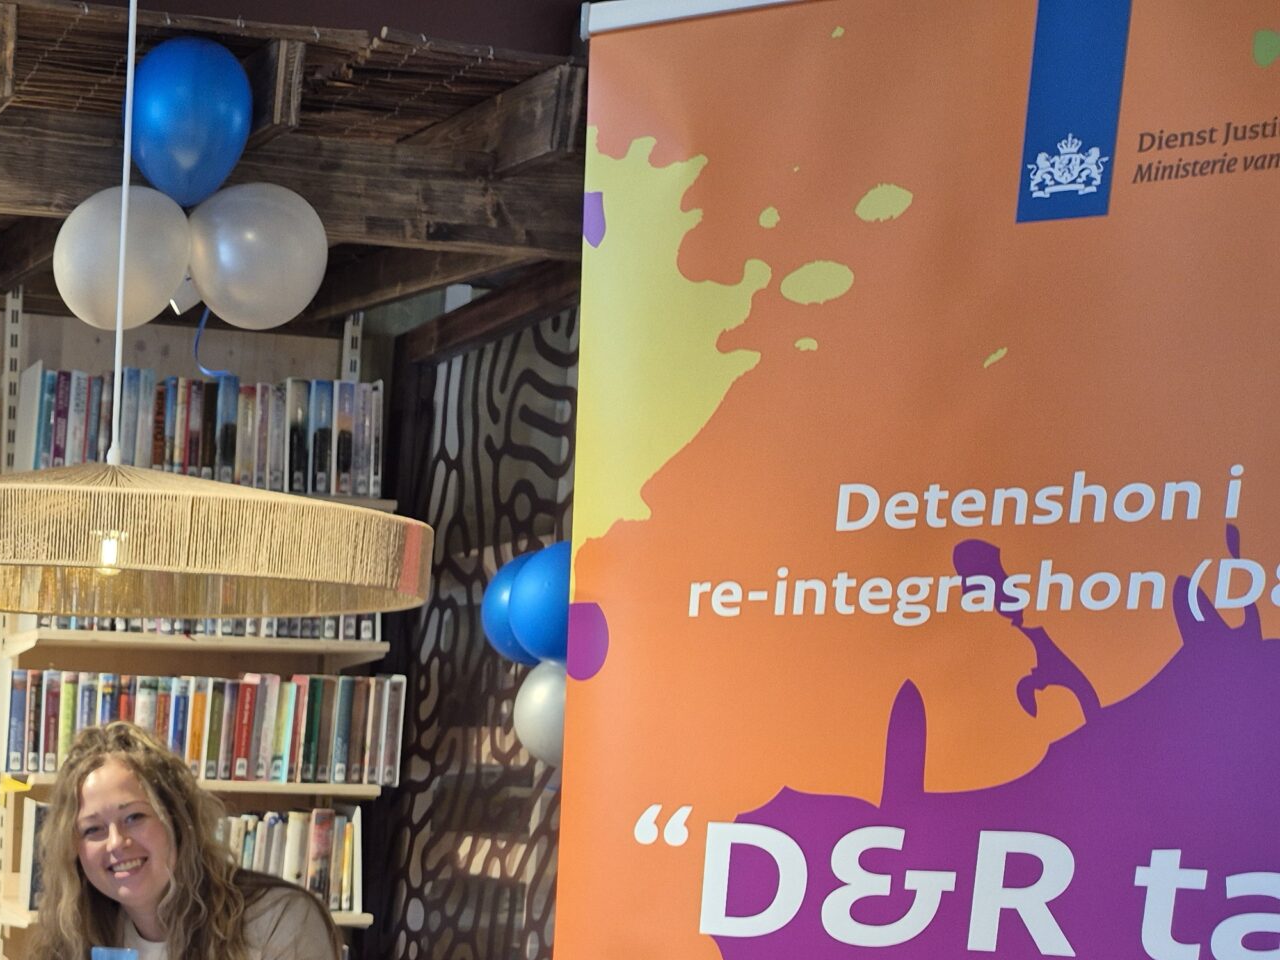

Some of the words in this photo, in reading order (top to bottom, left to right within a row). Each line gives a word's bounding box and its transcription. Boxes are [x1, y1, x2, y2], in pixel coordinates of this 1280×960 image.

[1137, 126, 1218, 153] Dienst
[1222, 116, 1280, 146] Justi
[1132, 151, 1238, 184] Ministerie
[1243, 152, 1280, 172] van
[835, 471, 1202, 532] Detenshon
[1225, 464, 1245, 519] i
[688, 559, 1166, 627] re-integrashon
[1187, 558, 1280, 622] (D
